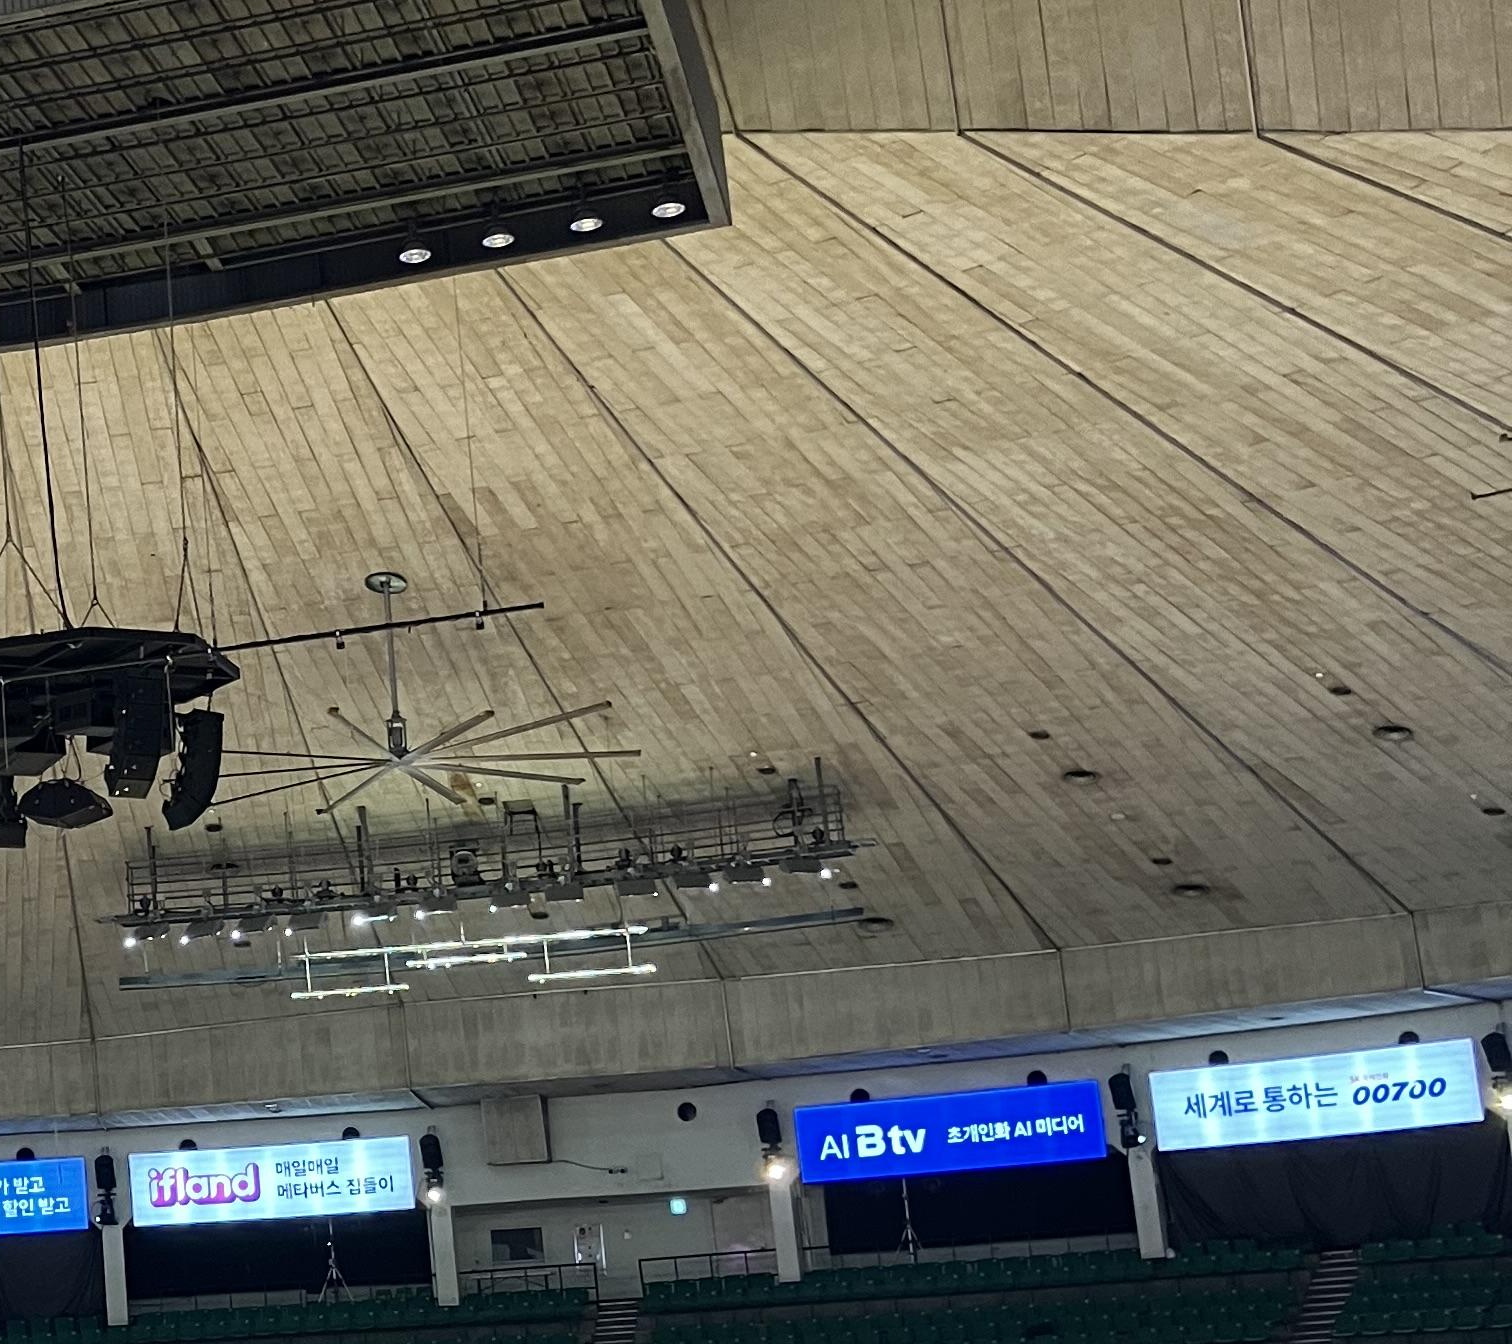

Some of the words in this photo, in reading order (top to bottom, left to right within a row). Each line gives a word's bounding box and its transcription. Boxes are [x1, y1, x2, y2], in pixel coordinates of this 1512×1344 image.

[1184, 1089, 1258, 1119] 세계로
[1262, 1082, 1338, 1113] 통하는
[1352, 1077, 1447, 1107] 00700
[820, 1134, 850, 1161] AI
[855, 1124, 926, 1158] Btv
[947, 1122, 1011, 1144] 초개인화
[1013, 1121, 1032, 1138] AI
[1035, 1113, 1085, 1136] 미디어
[275, 1157, 339, 1176] 매일매일
[13, 1176, 45, 1195] 받고
[148, 1162, 262, 1208] ifland
[277, 1181, 343, 1200] 메타버스
[346, 1175, 395, 1196] 집들이
[2, 1199, 34, 1218] 할인
[38, 1197, 71, 1216] 받고
